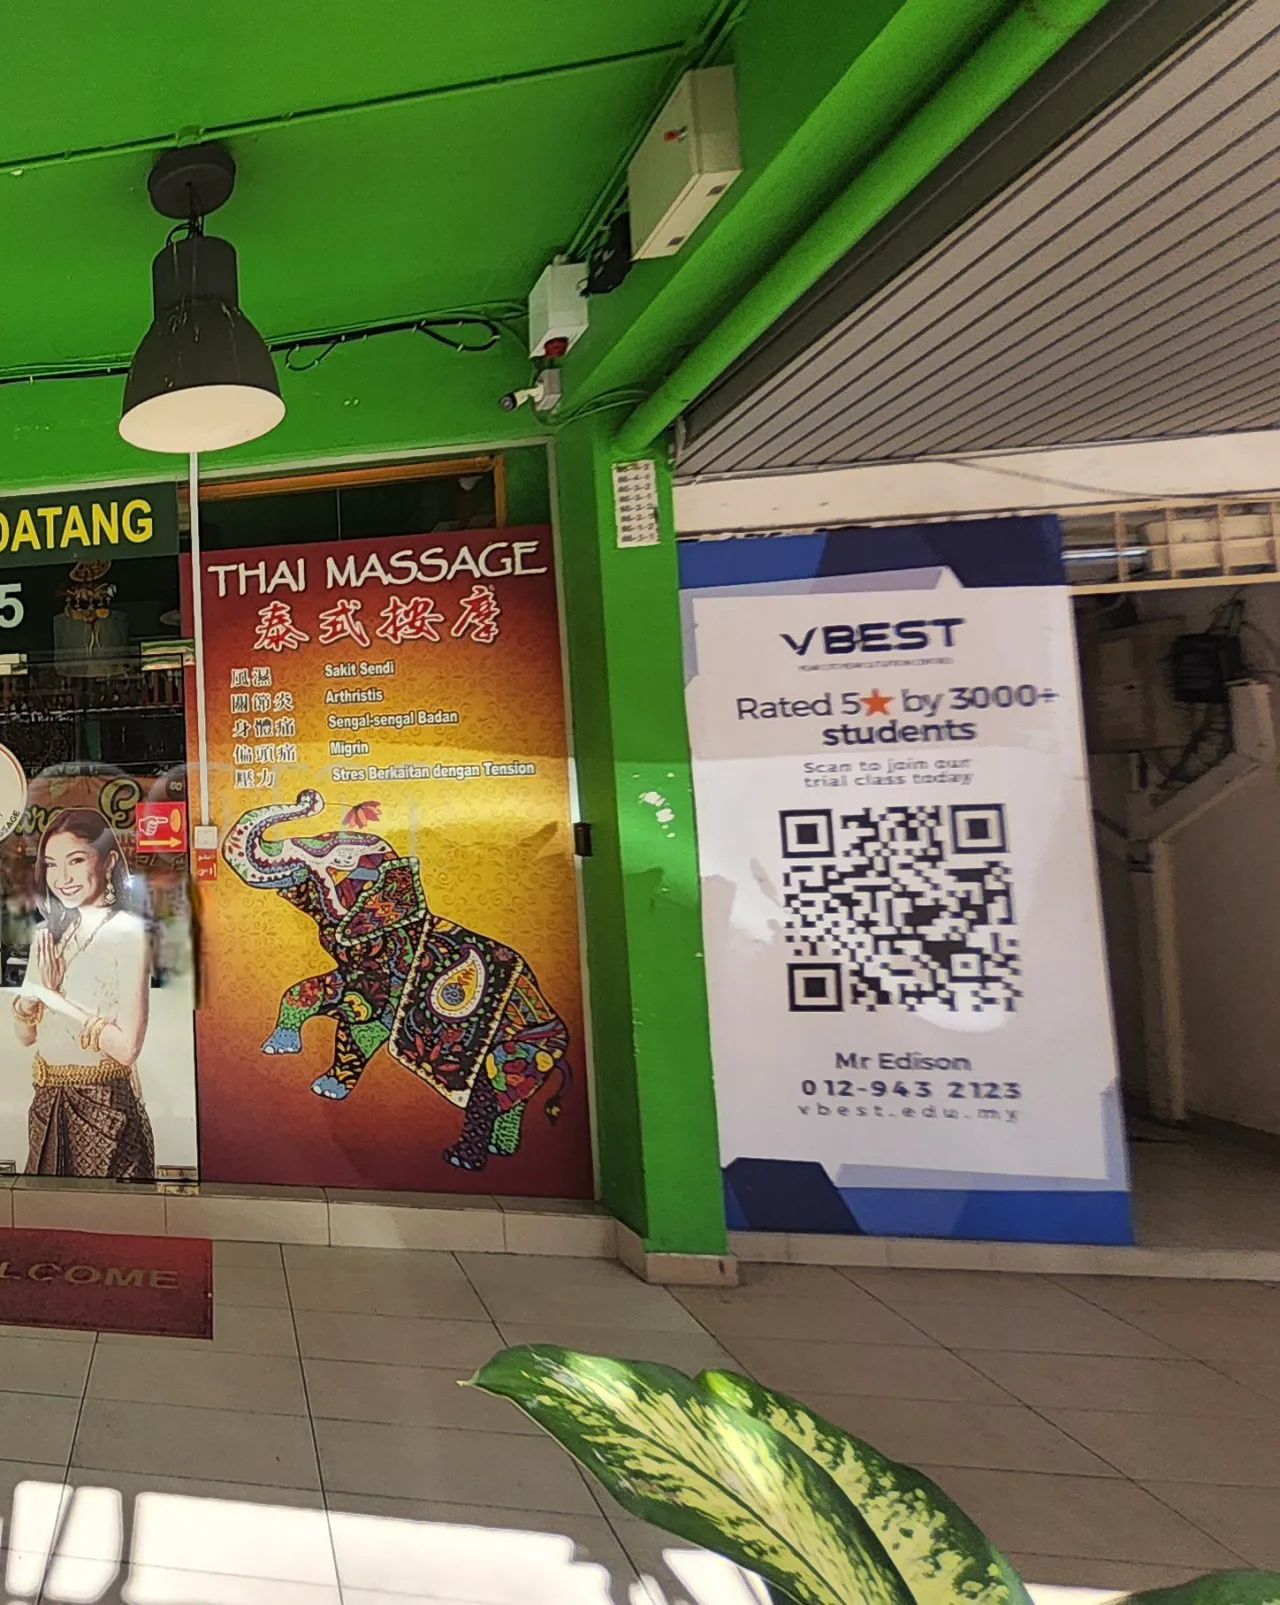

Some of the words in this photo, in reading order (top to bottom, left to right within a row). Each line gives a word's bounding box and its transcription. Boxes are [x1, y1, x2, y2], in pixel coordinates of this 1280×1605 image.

[207, 556, 307, 597] THAI
[326, 540, 548, 589] MASSAGE
[779, 617, 967, 656] VBEST
[324, 663, 357, 678] Sakit
[359, 660, 395, 676] Sendi
[325, 688, 384, 704] Arthristis
[736, 692, 834, 720] Rated
[840, 692, 862, 715] 5
[901, 687, 946, 717] by
[948, 684, 1060, 710] 3000+
[328, 711, 415, 731] Sengal-sengal
[417, 710, 458, 725] Badan
[822, 720, 977, 746] students
[329, 740, 370, 758] Migrin
[331, 766, 366, 782] Stres
[367, 764, 430, 781] Berkaitan
[433, 763, 480, 781] dengan
[482, 761, 535, 777] Tension
[804, 760, 852, 775] Scan
[859, 759, 881, 772] to
[887, 757, 928, 775] join
[934, 757, 973, 771] our
[804, 774, 847, 788] trial
[854, 772, 907, 786] class
[912, 770, 974, 787] today
[835, 1052, 873, 1070] Mr
[878, 1051, 973, 1071] Edison
[946, 1081, 1022, 1099] 2123
[797, 1102, 1018, 1124] vbest.edu.my
